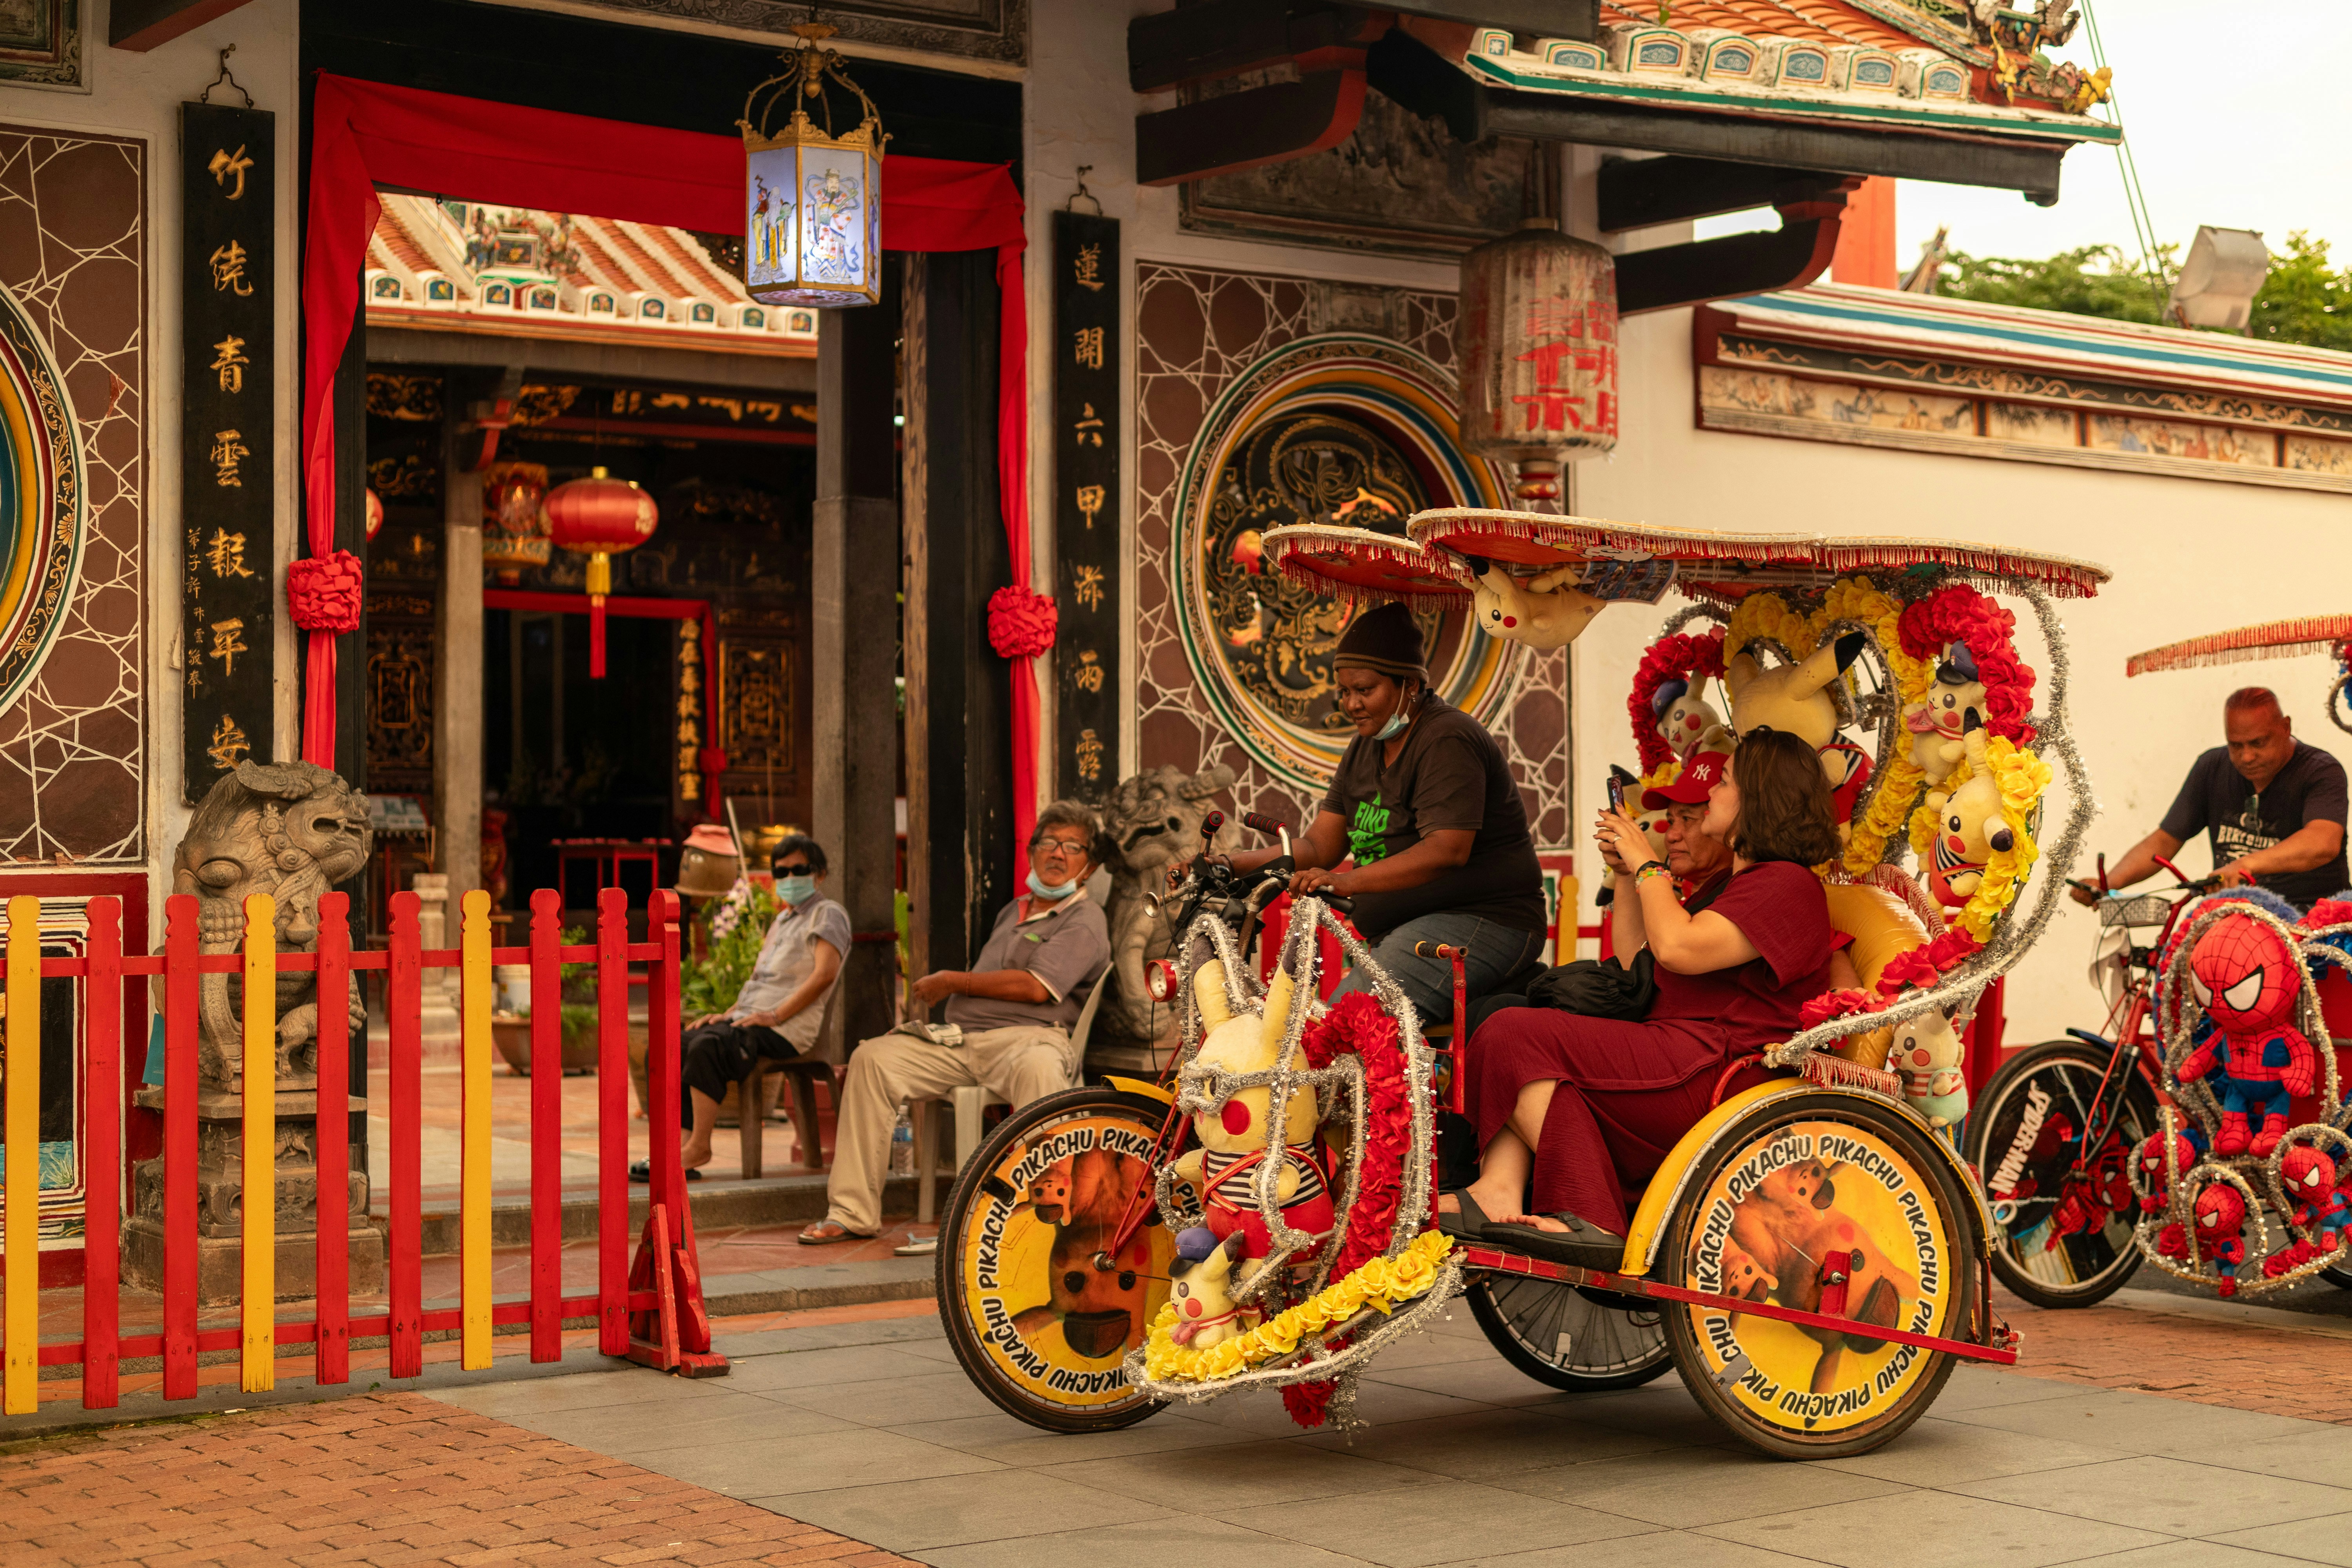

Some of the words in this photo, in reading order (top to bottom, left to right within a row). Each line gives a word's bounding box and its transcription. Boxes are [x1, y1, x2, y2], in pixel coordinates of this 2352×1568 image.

[1692, 764, 1711, 781] NY
[1011, 1129, 1093, 1191] PIKACHU
[1728, 1137, 1811, 1200] PIKACHU
[1819, 1137, 1904, 1190] PIKACHU
[1987, 1079, 2053, 1195] SPIDER-MAN
[978, 1200, 1014, 1289] PIKACH
[1699, 1200, 1732, 1307] IKACHU
[1899, 1191, 1937, 1294] PIKACHU
[982, 1298, 1049, 1379] PIKACHU
[1706, 1318, 1779, 1403] PIKCHU
[1048, 1368, 1130, 1394] IKACHU
[1779, 1383, 1871, 1416] PIKACHU
